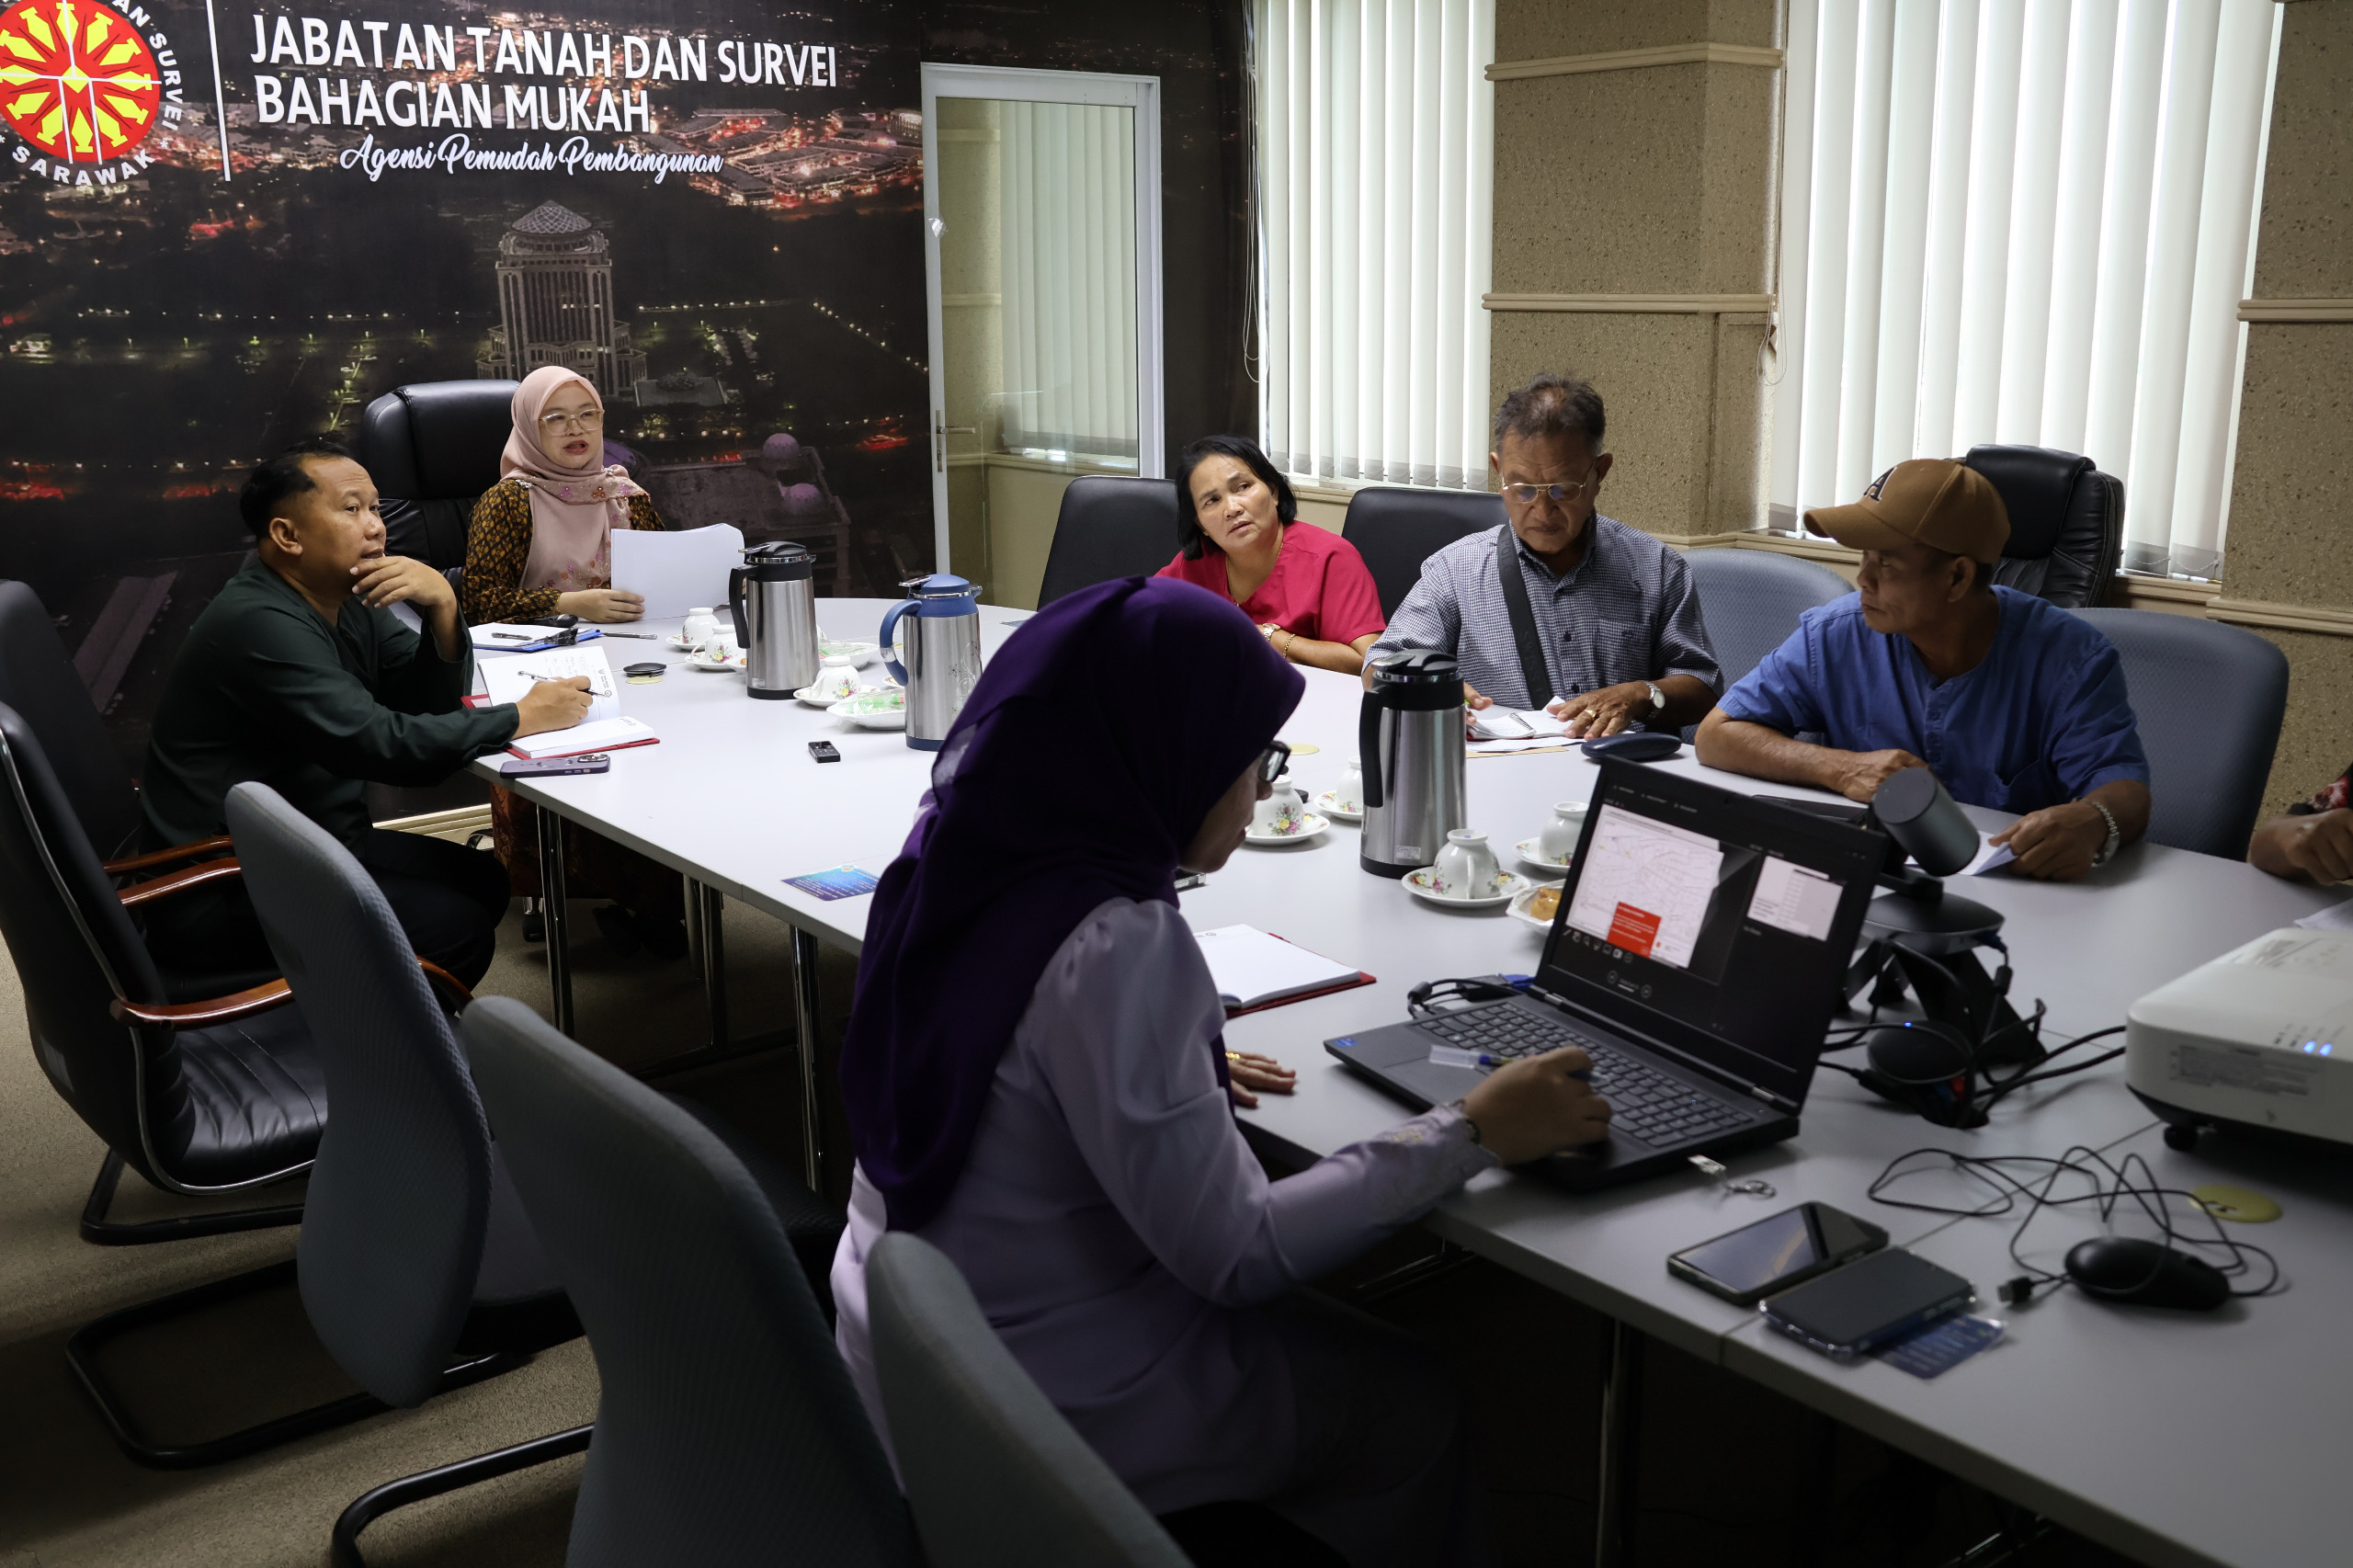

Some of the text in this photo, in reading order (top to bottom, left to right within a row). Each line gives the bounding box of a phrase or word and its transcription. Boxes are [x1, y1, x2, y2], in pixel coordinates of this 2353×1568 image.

[111, 0, 184, 131] AN SURVEI
[250, 14, 836, 87] JABATAN TANAH DAN SURVEI
[254, 74, 651, 133] BAHAGIAN MUKAH
[12, 145, 156, 186] SARAWAK
[339, 132, 724, 185] Agensi Pemudah Pembangunan
[1864, 466, 1897, 502] A
